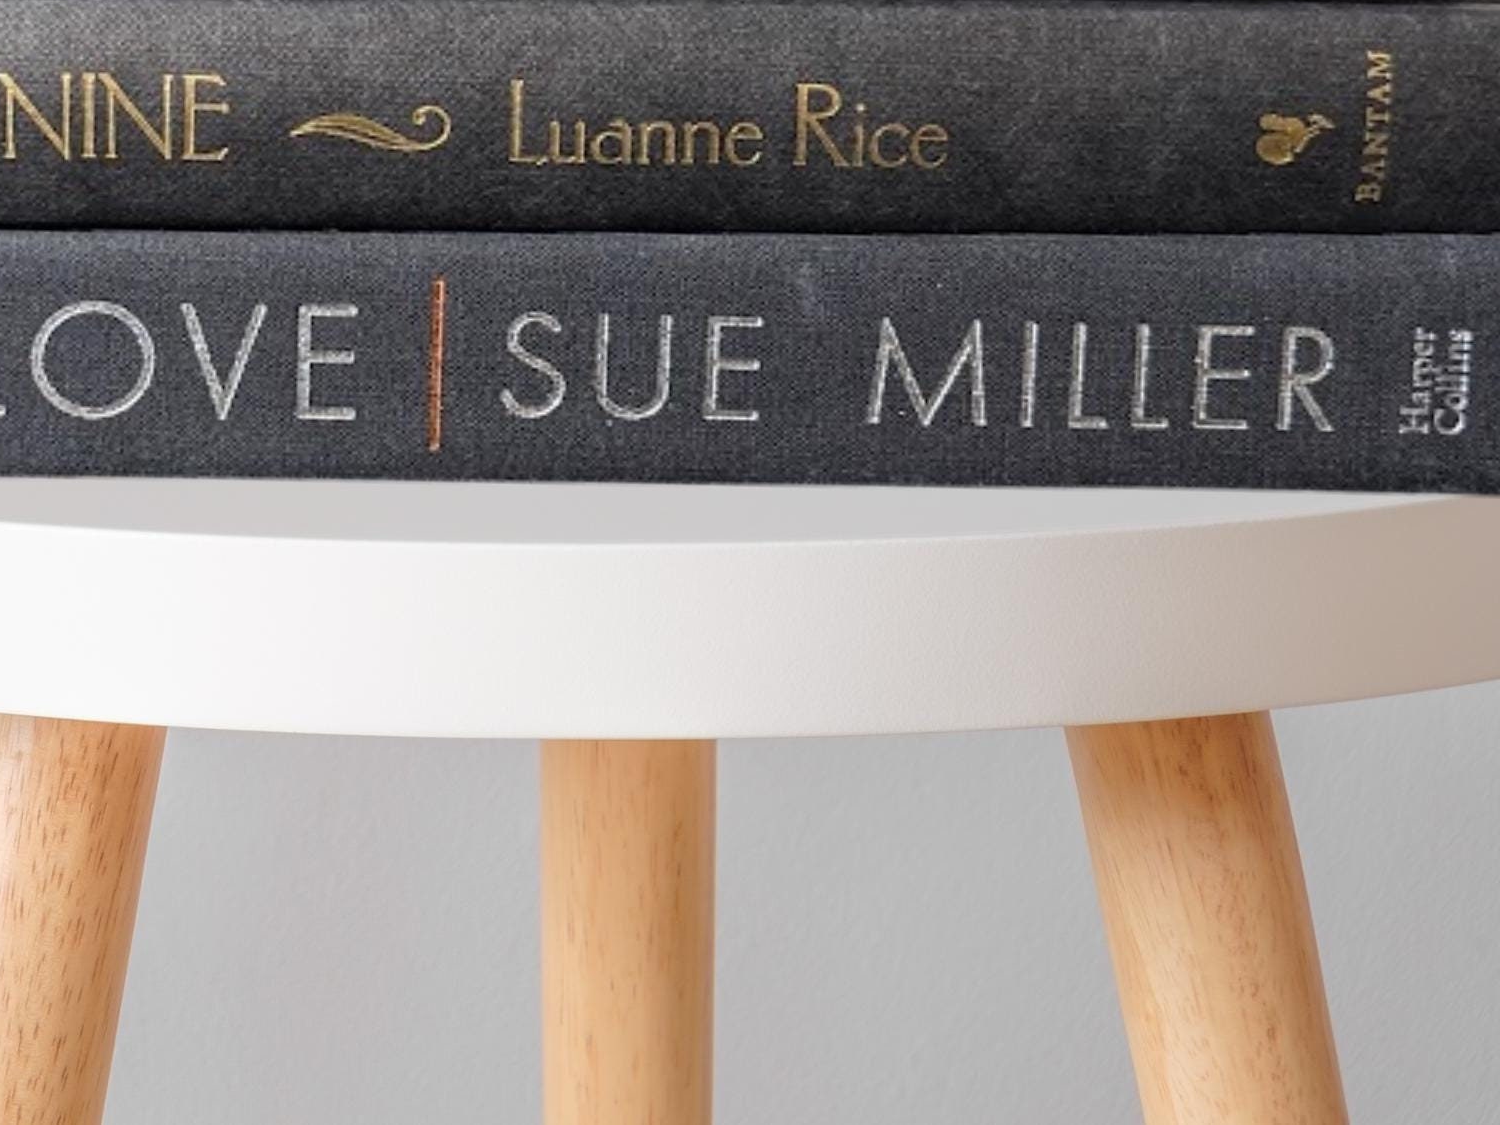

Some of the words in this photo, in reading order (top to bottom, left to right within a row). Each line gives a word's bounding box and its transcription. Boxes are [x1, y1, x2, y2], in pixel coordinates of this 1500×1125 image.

[508, 78, 764, 166] Luanne
[792, 82, 949, 168] Rice
[1354, 50, 1393, 203] BANTAM
[500, 311, 765, 421] SUE
[866, 316, 1337, 433] MILLER
[1398, 327, 1438, 435] Harper
[1433, 328, 1474, 436] Collins
